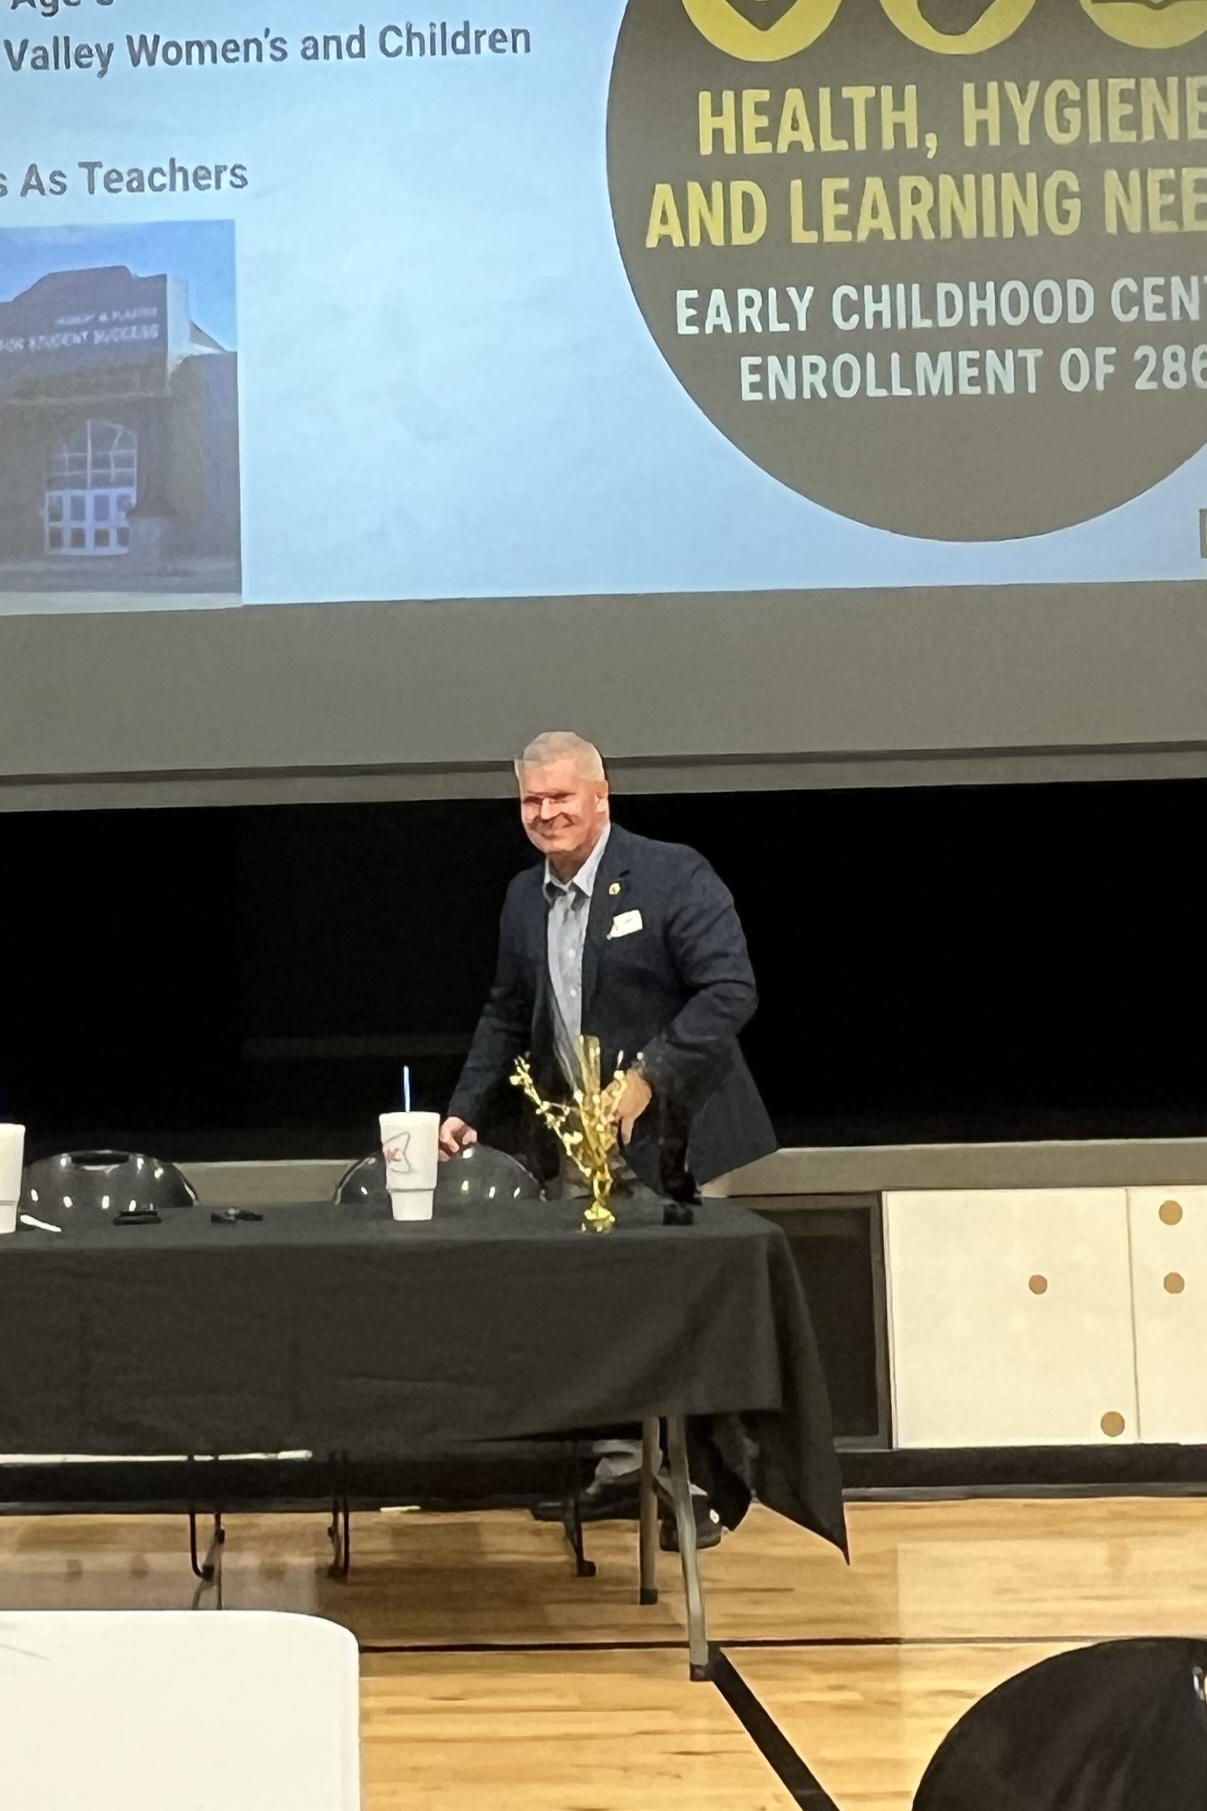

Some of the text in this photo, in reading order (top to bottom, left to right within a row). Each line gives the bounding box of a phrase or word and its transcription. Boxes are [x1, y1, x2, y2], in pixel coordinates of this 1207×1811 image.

[3, 35, 114, 79] Valley
[126, 27, 288, 68] Women's
[300, 24, 366, 61] and
[378, 20, 532, 58] Children
[698, 75, 1207, 160] HEALTH, HYGIENE
[19, 162, 68, 198] As
[77, 156, 249, 196] Teachers
[645, 180, 768, 249] AND
[790, 169, 1082, 244] LEARNING
[676, 274, 1207, 335] EARLY CHILDHOOD CEN
[740, 348, 1044, 401] ENROLLMENT
[1059, 346, 1117, 393] OF
